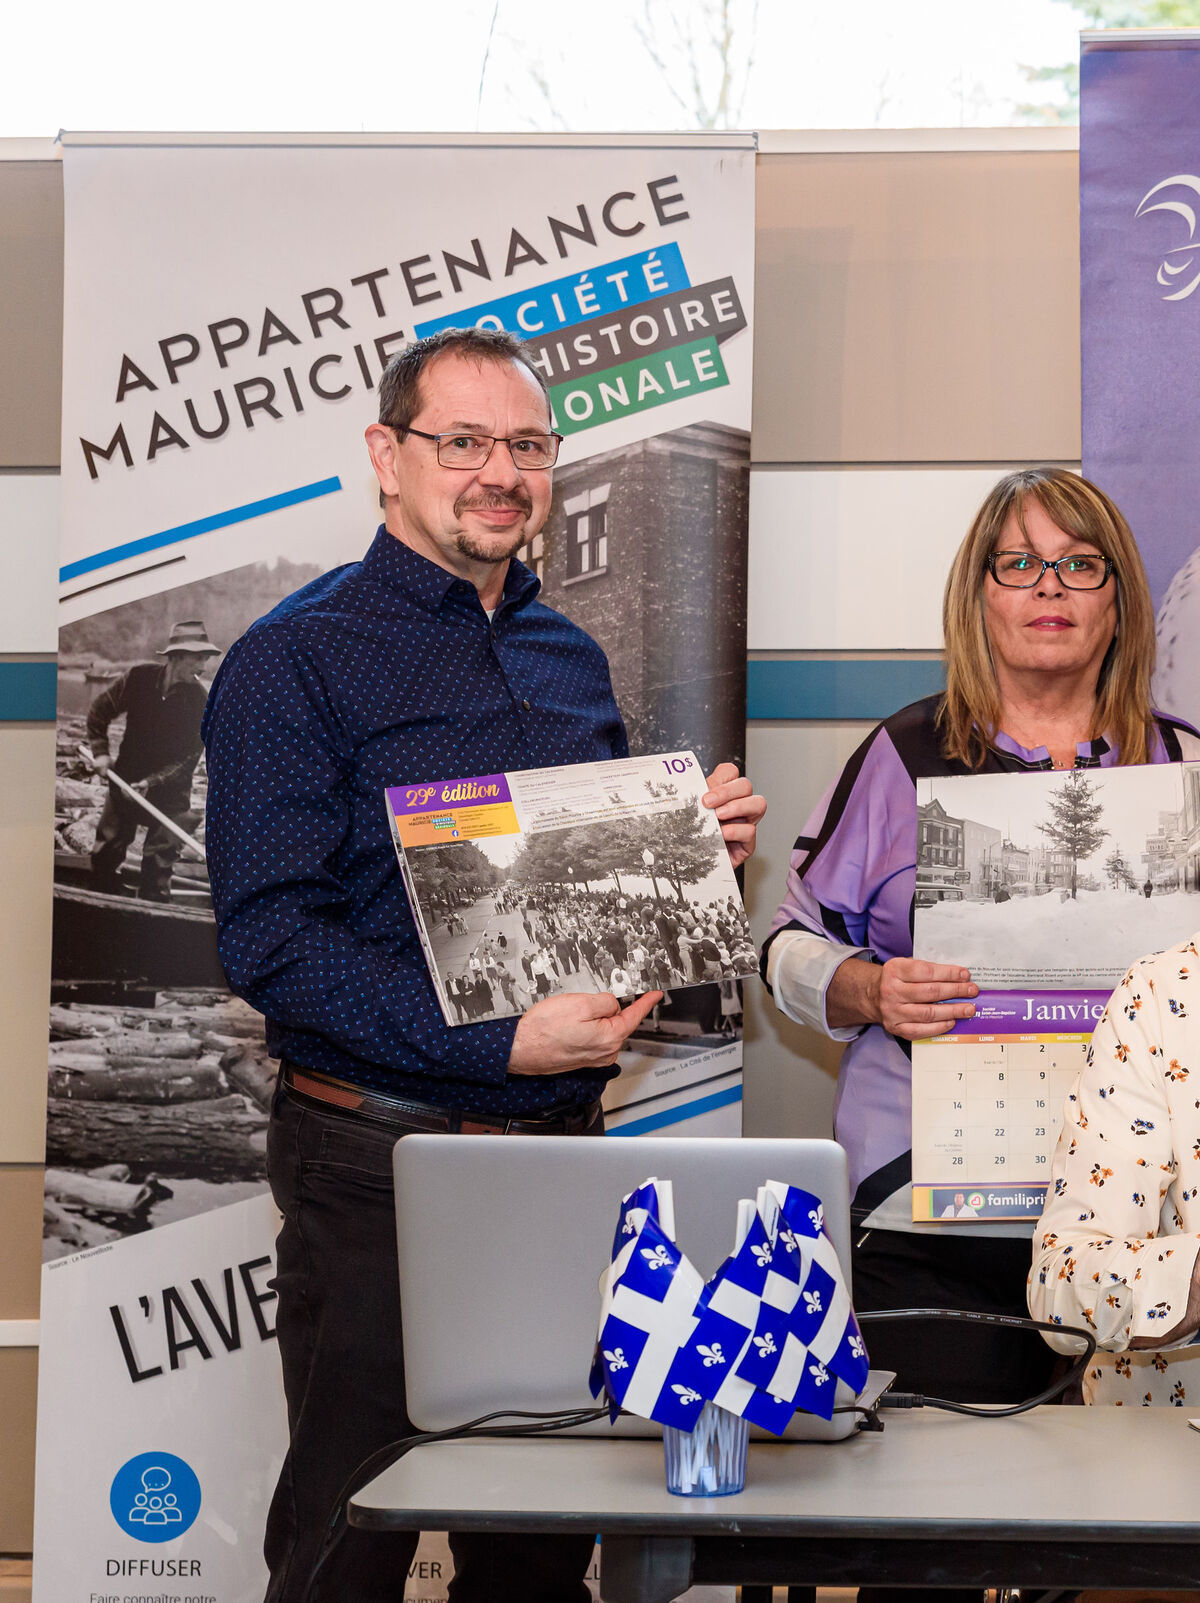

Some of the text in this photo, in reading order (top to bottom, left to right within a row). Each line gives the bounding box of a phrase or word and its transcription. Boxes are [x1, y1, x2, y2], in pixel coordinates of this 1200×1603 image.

[114, 174, 691, 404] APPARTENANCE
[662, 757, 694, 776] 10$
[405, 786, 436, 808] 29e
[441, 782, 500, 803] édition
[1022, 999, 1105, 1021] Janvie
[1040, 1044, 1045, 1052] 2
[1082, 1044, 1087, 1052] 3
[958, 1072, 1046, 1081] 7 8 9
[953, 1100, 1045, 1110] 14 15 16
[954, 1128, 1046, 1137] 21 22 23
[952, 1155, 1046, 1165] 28 29 30
[988, 1193, 1046, 1208] familipri
[109, 1255, 278, 1383] L'AVE
[106, 1559, 202, 1577] DIFFUSER
